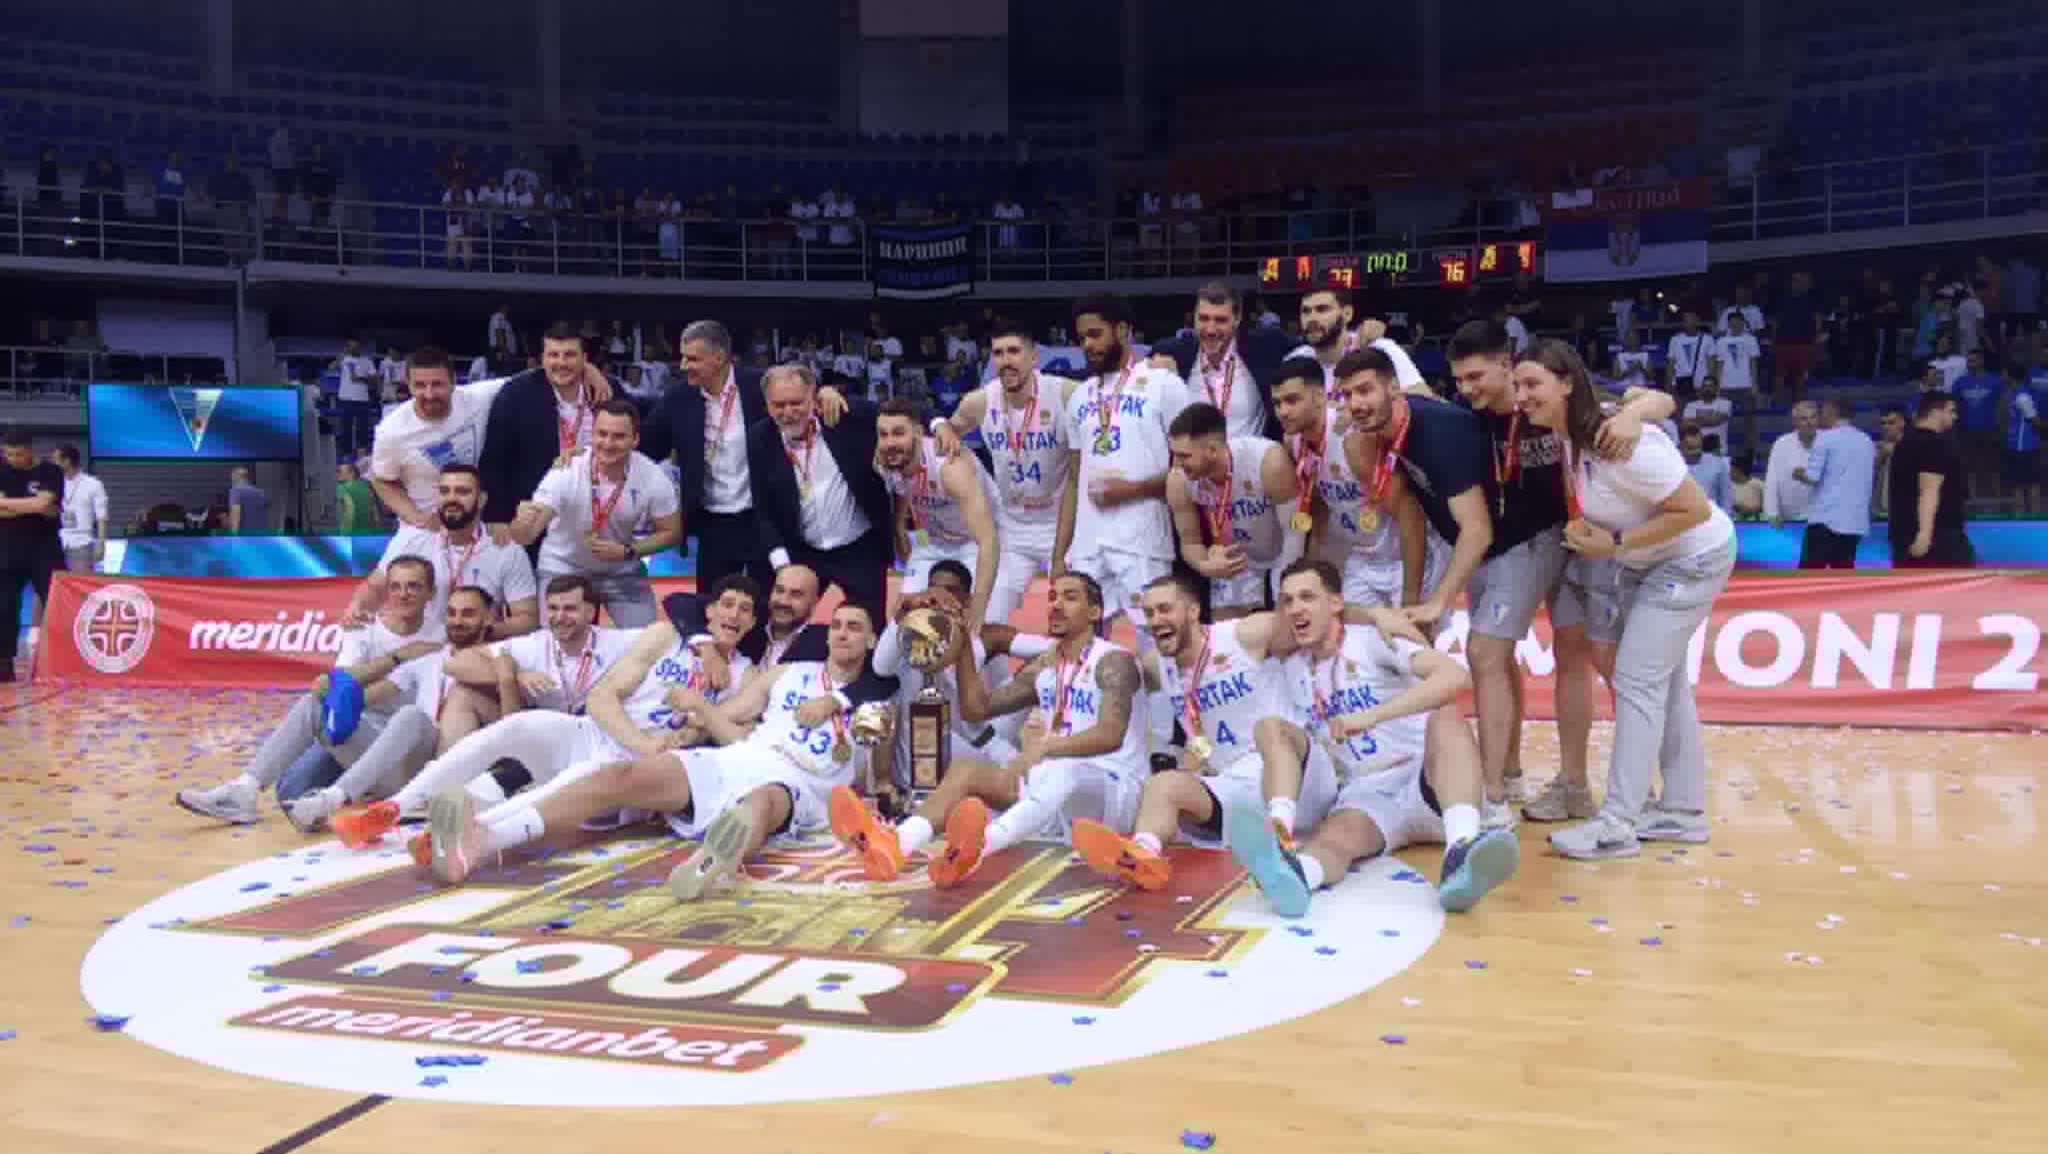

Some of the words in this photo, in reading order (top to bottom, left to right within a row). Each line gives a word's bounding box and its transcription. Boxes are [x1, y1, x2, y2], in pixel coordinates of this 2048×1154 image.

[1007, 460, 1041, 484] 34
[335, 931, 908, 1015] FOUR
[255, 1004, 772, 1067] meridianbet
